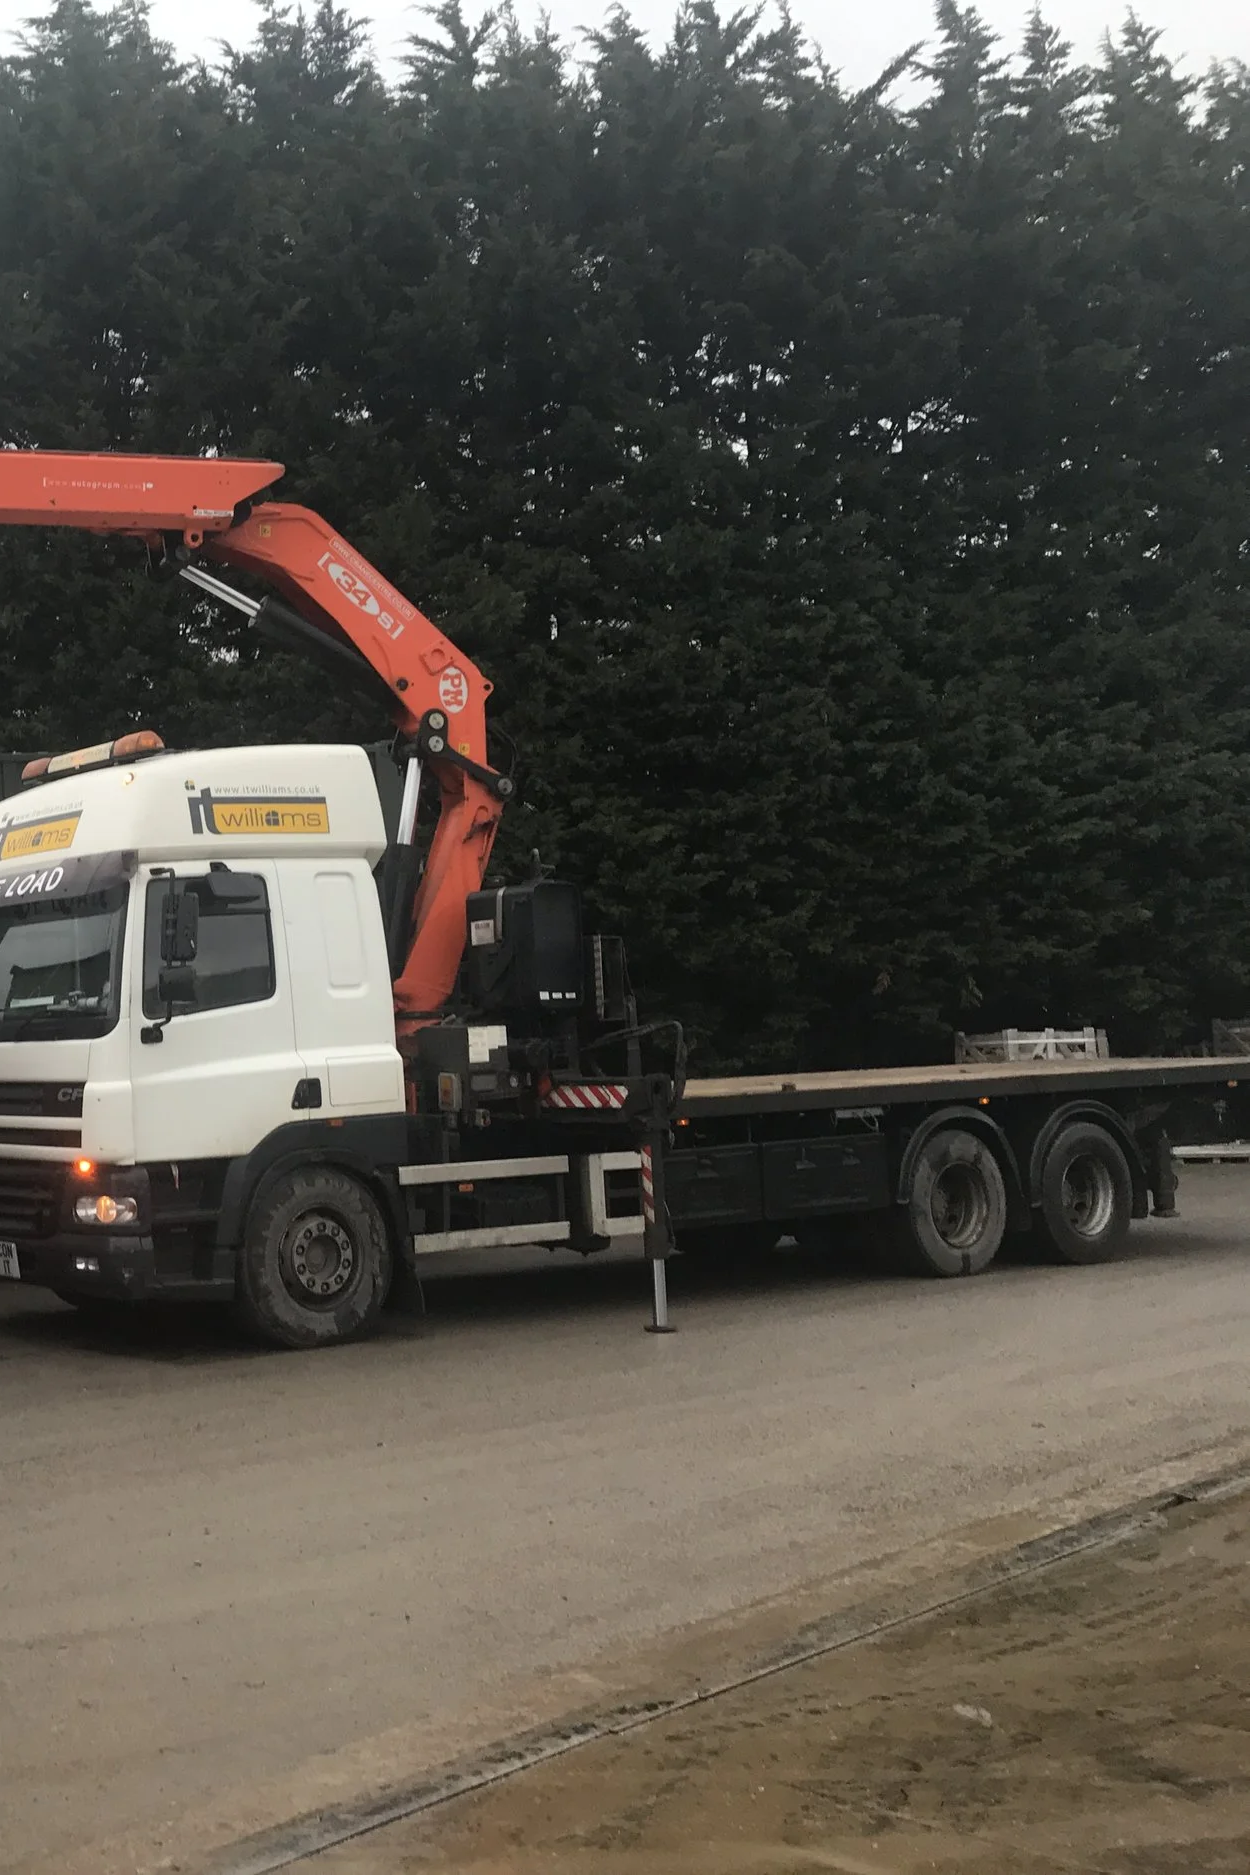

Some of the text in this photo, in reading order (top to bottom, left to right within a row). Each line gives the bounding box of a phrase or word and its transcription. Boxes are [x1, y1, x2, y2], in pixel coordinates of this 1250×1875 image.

[336, 570, 371, 607] 34
[442, 673, 463, 706] PM
[214, 784, 321, 796] www.itwilliams.co.uk
[221, 808, 321, 827] williams
[6, 827, 71, 853] williams
[4, 866, 64, 898] LOAD
[57, 1087, 84, 1102] CF
